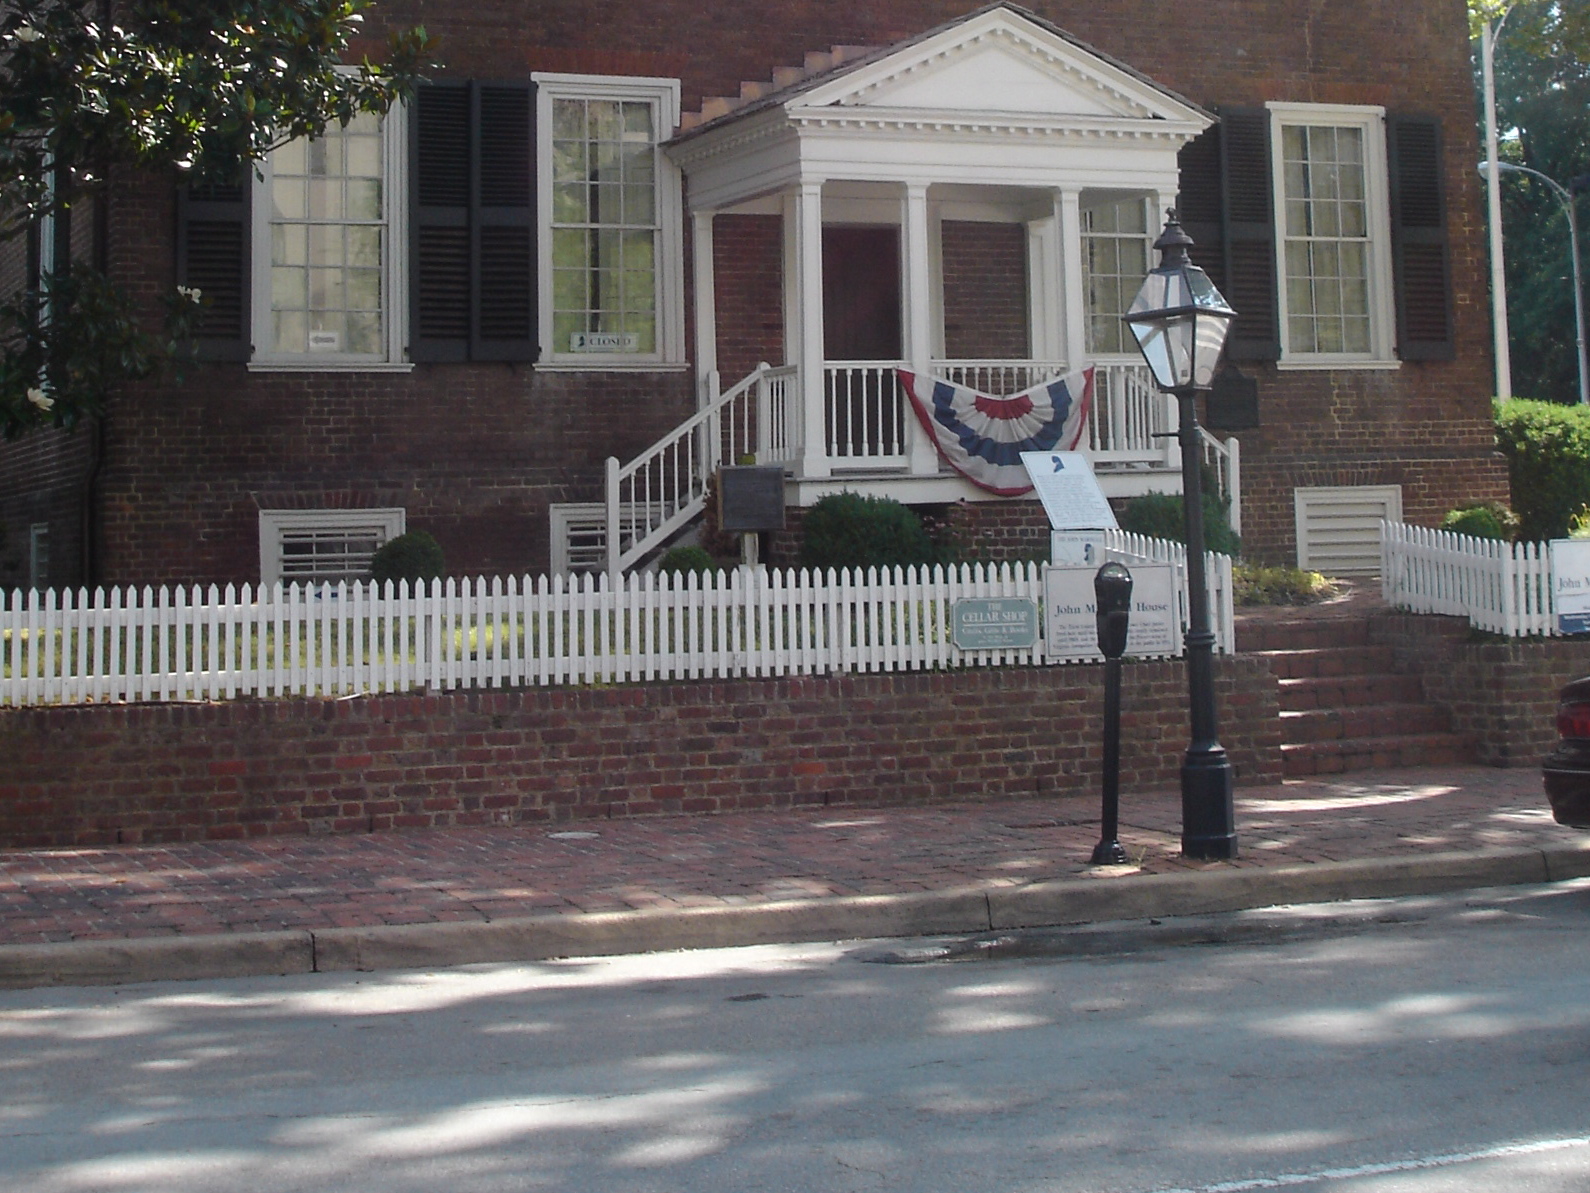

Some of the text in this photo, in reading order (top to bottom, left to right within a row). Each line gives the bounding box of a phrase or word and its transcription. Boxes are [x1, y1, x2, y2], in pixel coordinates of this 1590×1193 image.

[1558, 577, 1581, 592] John
[962, 610, 1028, 623] CELLAR SHOP
[1054, 604, 1081, 617] John
[1136, 602, 1168, 612] House
